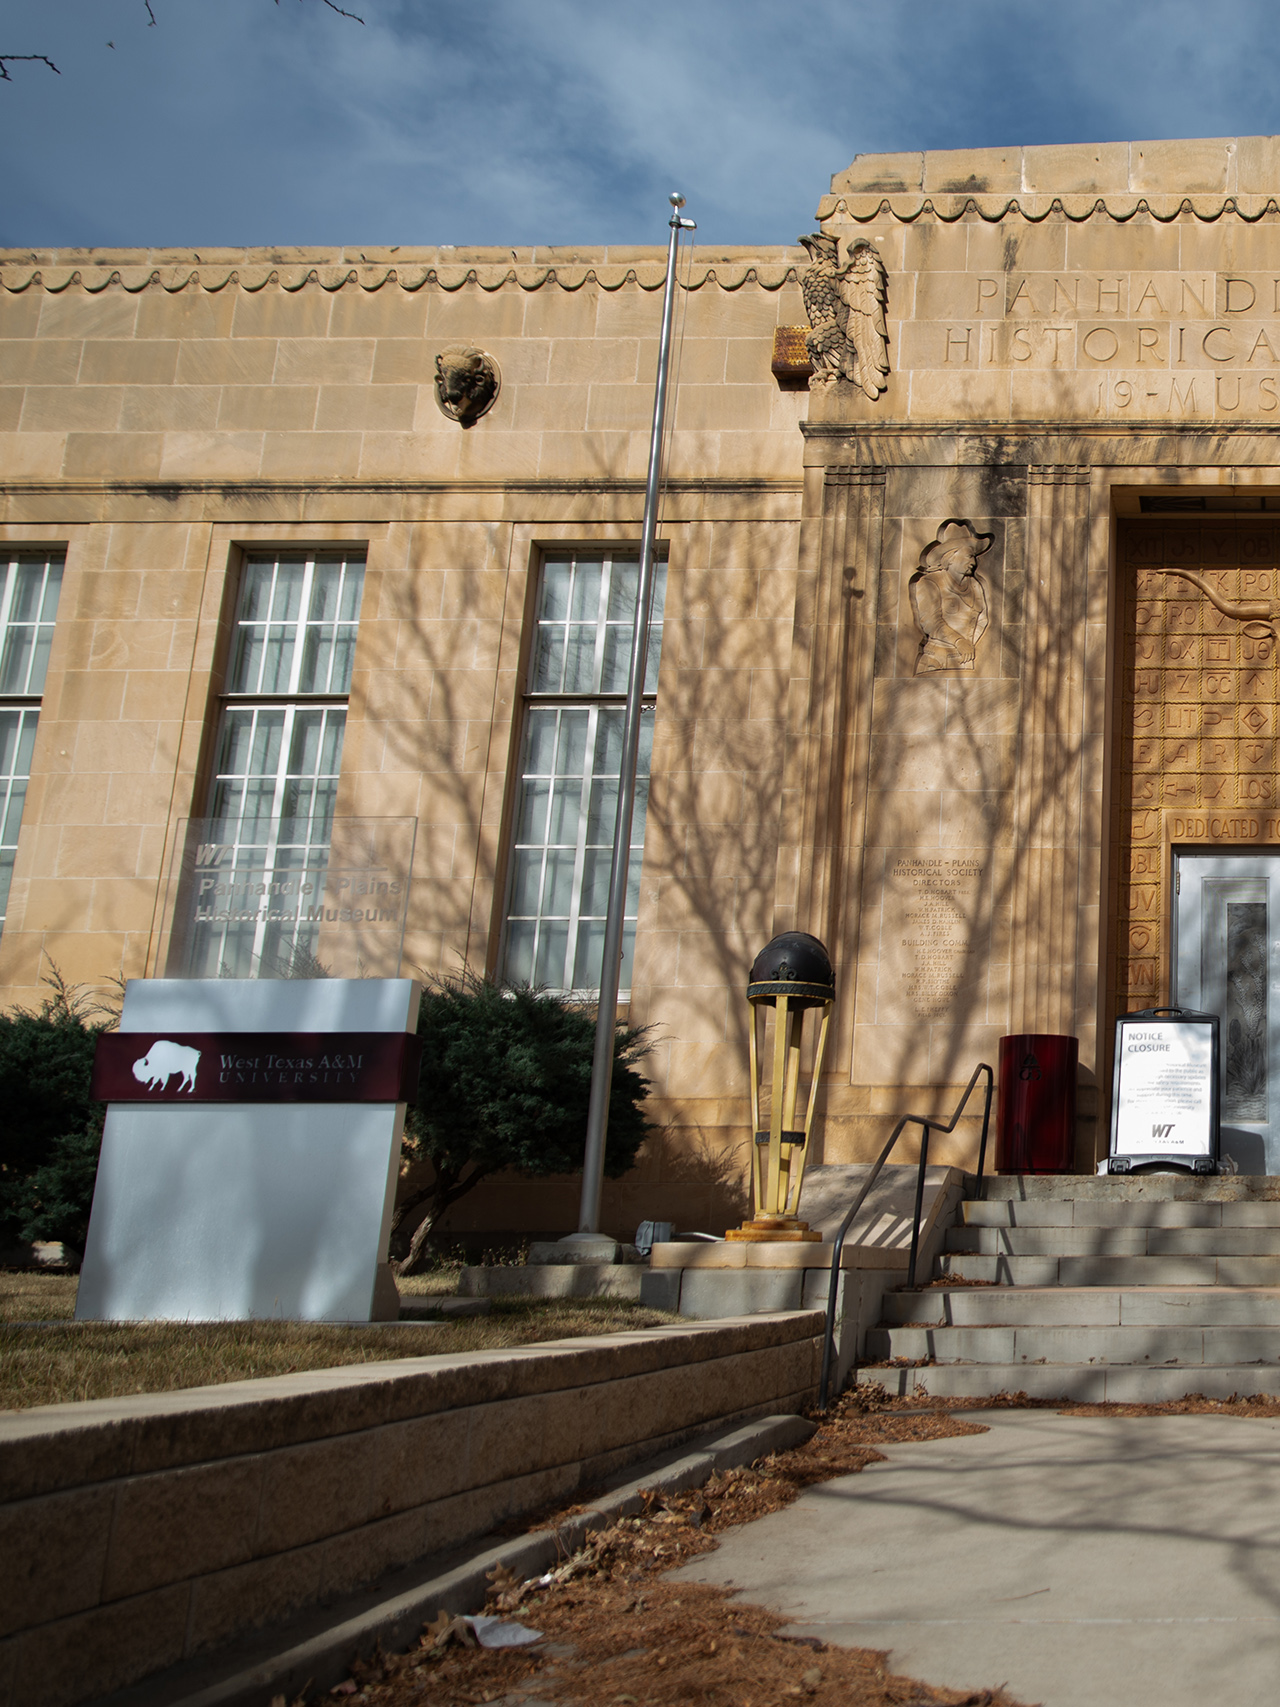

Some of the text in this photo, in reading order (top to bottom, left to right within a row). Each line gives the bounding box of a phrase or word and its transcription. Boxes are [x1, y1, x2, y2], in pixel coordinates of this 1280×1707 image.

[1174, 818, 1259, 839] DEDICATED
[195, 844, 234, 866] WT
[897, 859, 943, 867] PANHANDLE
[952, 859, 980, 867] PLAINS
[893, 868, 984, 877] HISTORICAL SOCIETY
[199, 878, 314, 896] Panhandle
[335, 876, 402, 896] Plains
[913, 879, 961, 887] DIRECTORS
[194, 904, 399, 923] Historical Museum
[901, 939, 938, 947] BUILDING
[1128, 1032, 1164, 1041] NOTICE
[1128, 1043, 1171, 1053] CLOSURE
[219, 1054, 364, 1069] West Texas A&M
[219, 1072, 360, 1083] UNIVERSITY
[1152, 1124, 1176, 1138] WT
